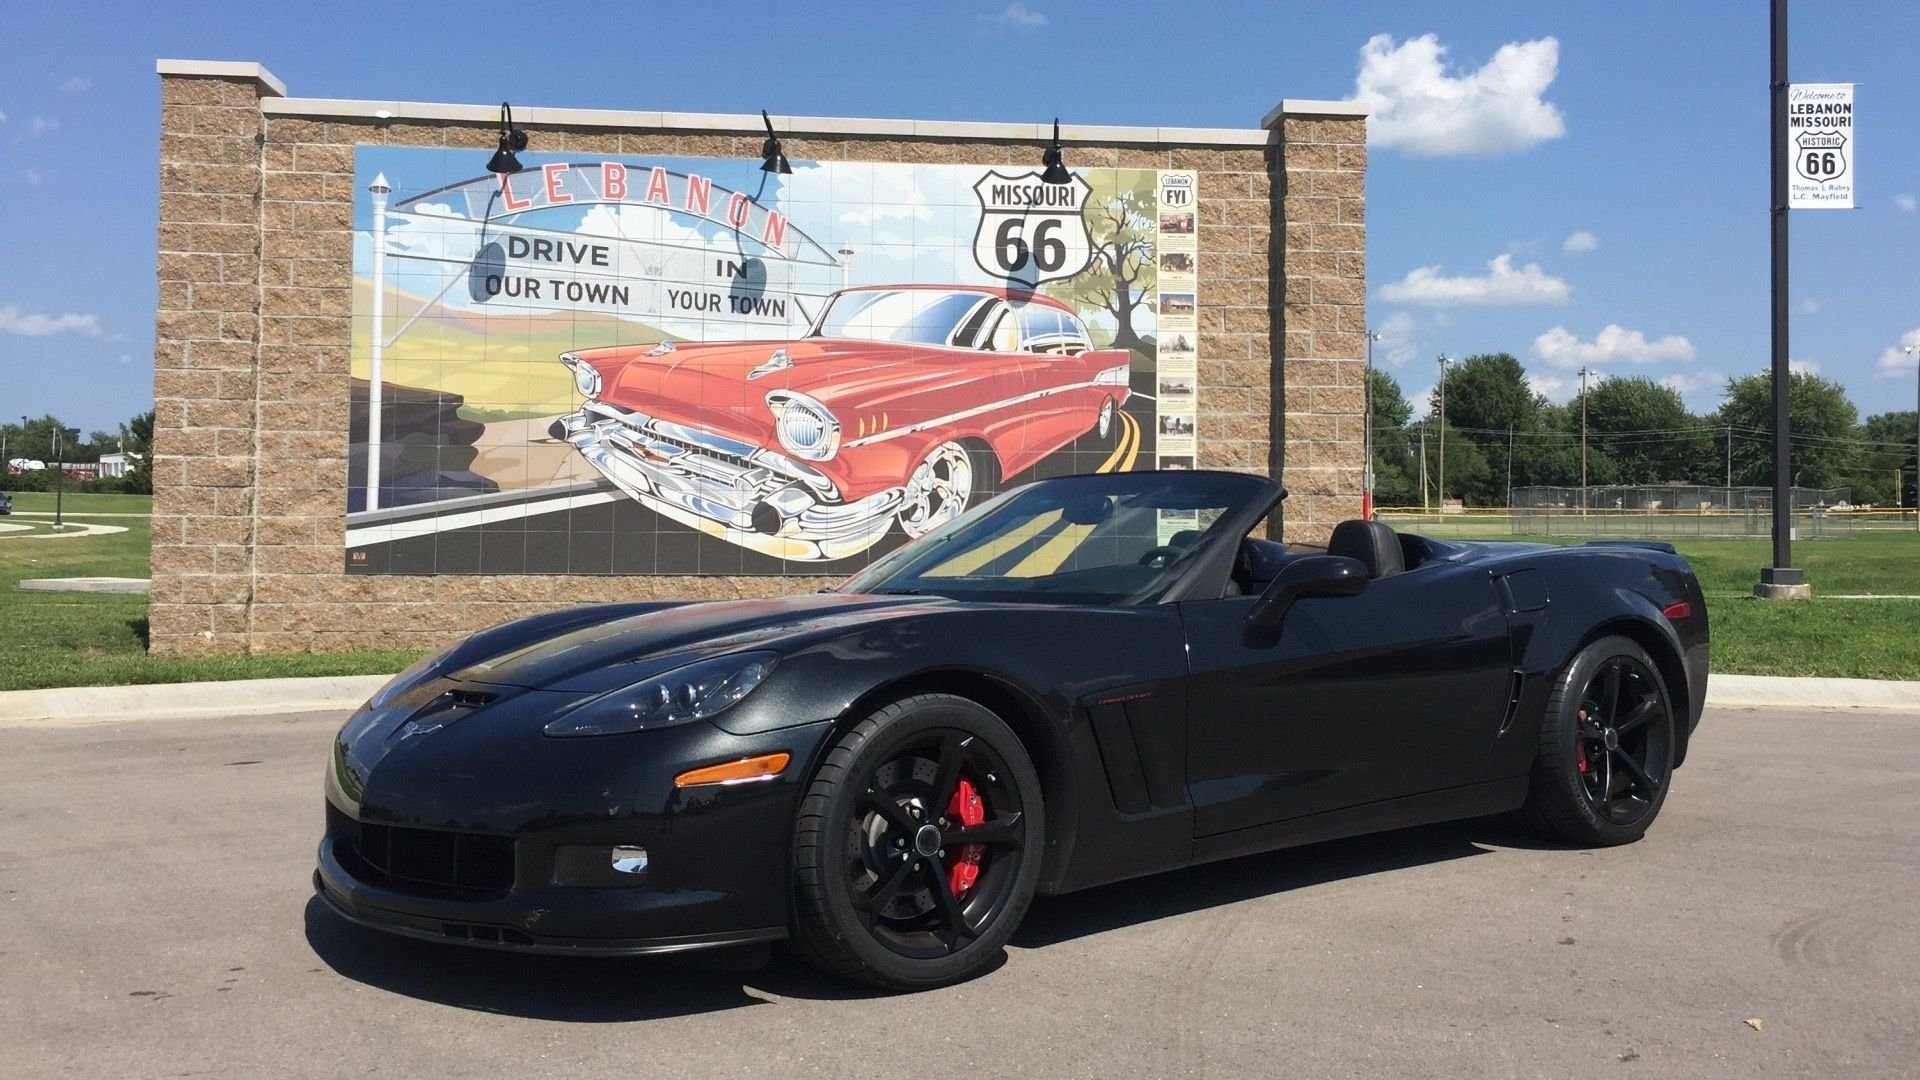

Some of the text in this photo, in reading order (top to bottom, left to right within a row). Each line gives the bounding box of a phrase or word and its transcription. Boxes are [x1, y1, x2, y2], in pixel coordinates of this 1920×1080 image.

[1790, 89, 1846, 101] Welcome to
[1790, 103, 1851, 115] LEBANON
[1790, 116, 1852, 128] MISSOURI
[1802, 137, 1841, 146] HISTORIC
[1806, 152, 1836, 175] 66
[992, 184, 1075, 207] MISSOURI
[1166, 189, 1186, 204] FYI
[1792, 184, 1819, 192] Thomas
[1812, 193, 1848, 201] Mayfield
[496, 161, 789, 250] LEBANON
[508, 235, 609, 268] DRIVE
[995, 218, 1066, 272] 66
[716, 260, 748, 280] IN
[485, 274, 630, 306] OUR TOWN
[668, 289, 786, 319] YOUR TOWN
